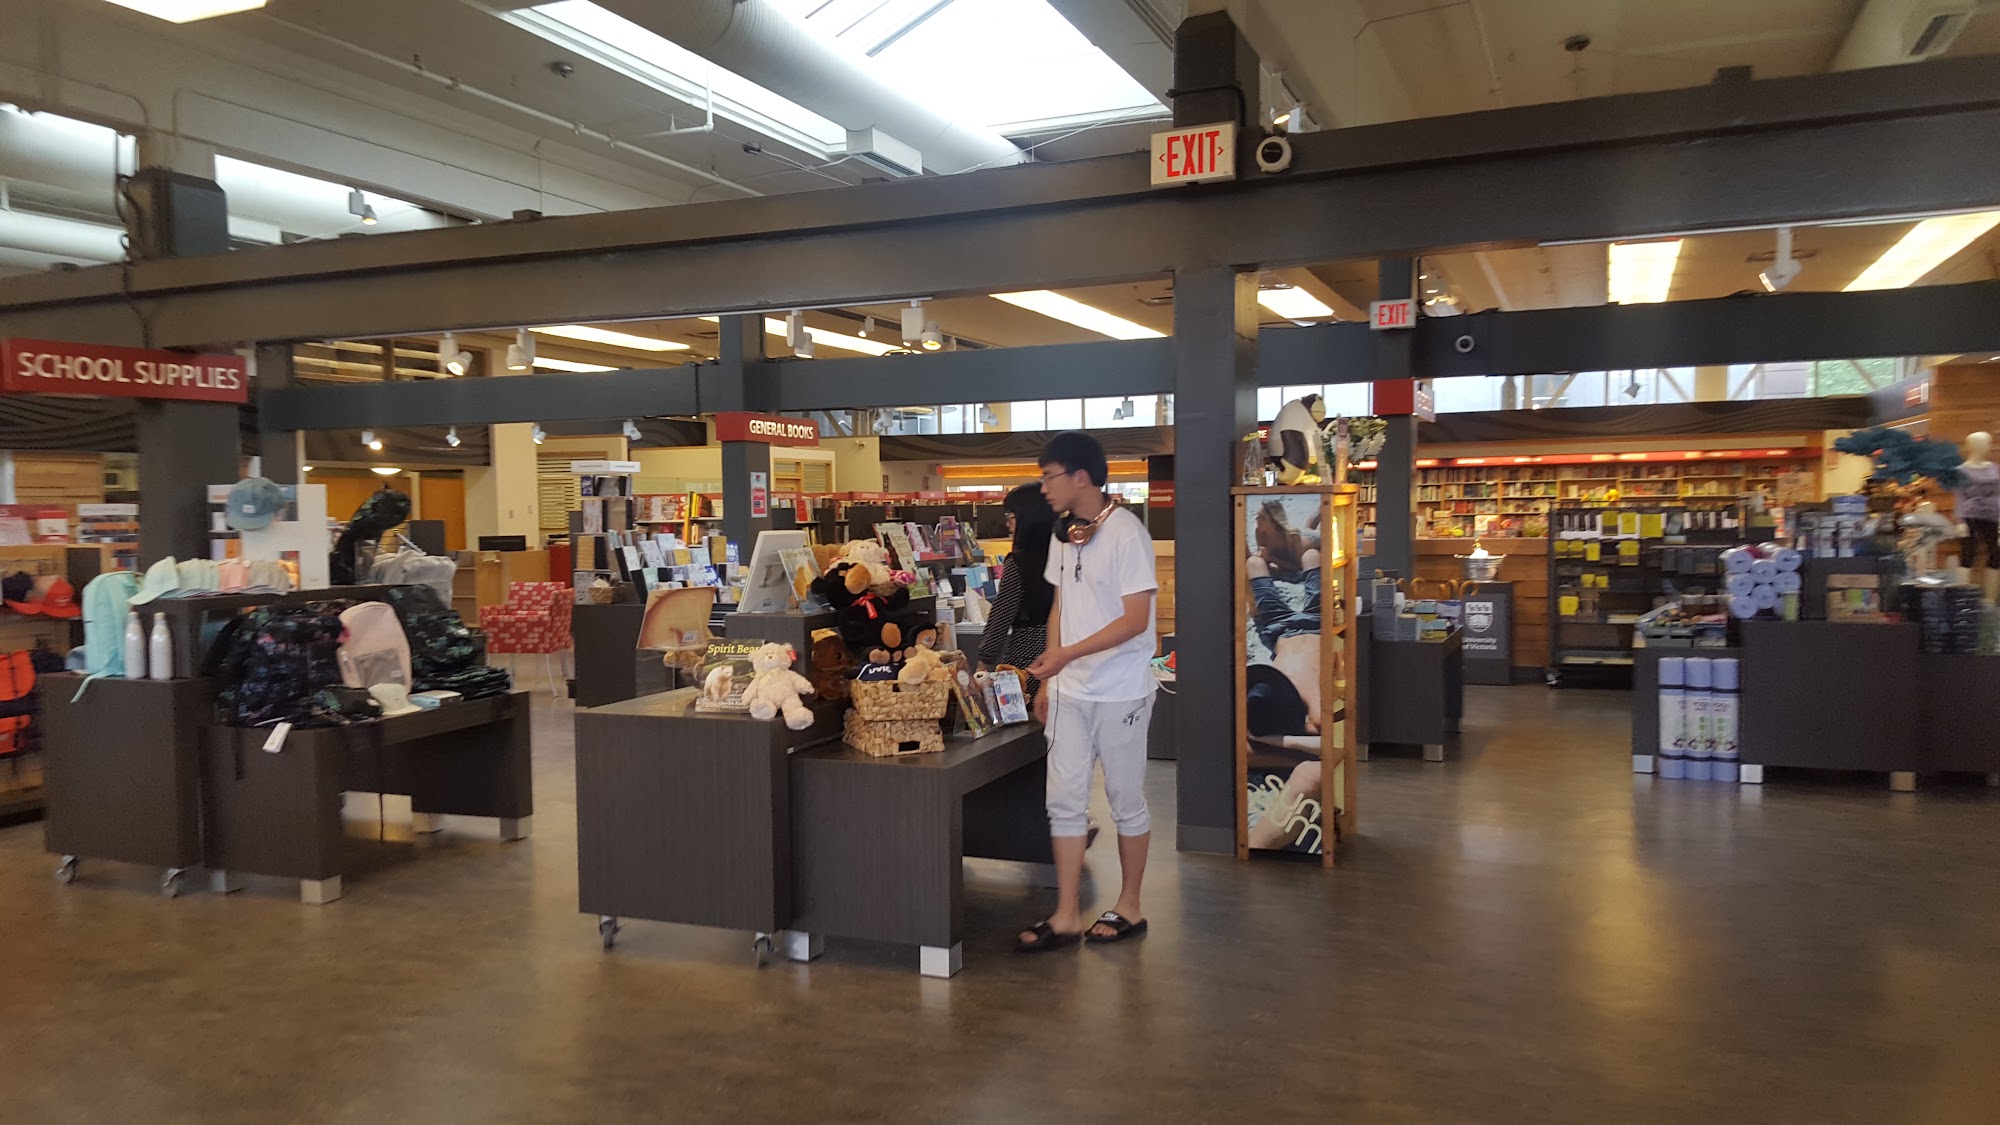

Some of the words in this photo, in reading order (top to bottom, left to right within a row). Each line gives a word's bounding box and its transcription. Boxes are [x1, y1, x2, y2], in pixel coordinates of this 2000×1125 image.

[1167, 131, 1220, 177] EXIT
[1378, 303, 1408, 326] EXIT
[17, 351, 130, 382] SCHOOL
[134, 361, 241, 390] SUPPLIES
[749, 419, 787, 437] GENERAL
[787, 423, 814, 440] BOOKS
[707, 643, 735, 655] Spirit
[737, 644, 760, 654] Bear
